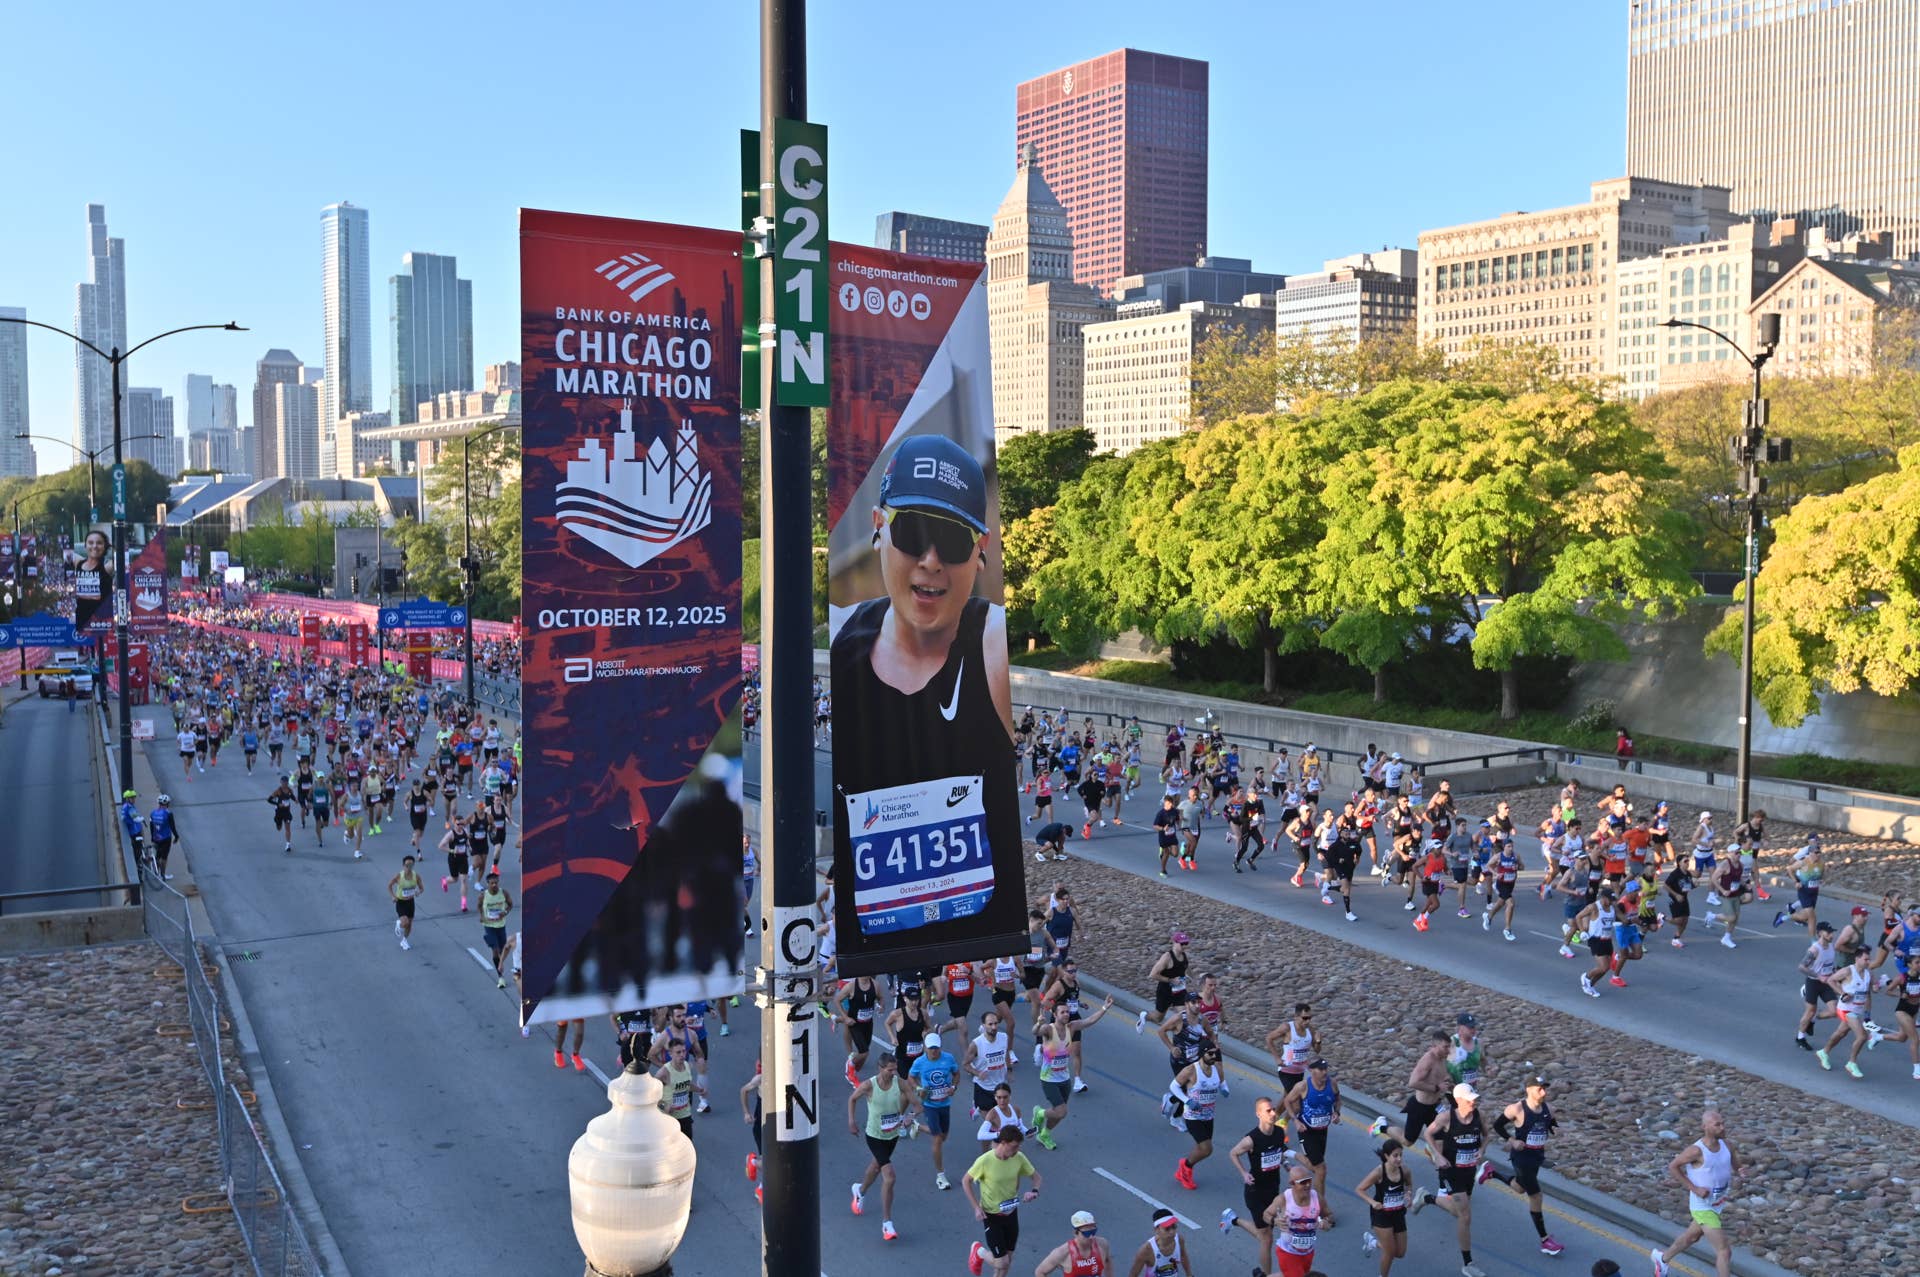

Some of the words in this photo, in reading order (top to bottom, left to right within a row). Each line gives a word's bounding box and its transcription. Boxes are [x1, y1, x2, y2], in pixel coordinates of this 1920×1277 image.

[779, 144, 824, 384] C21N
[837, 260, 958, 287] chicagomarathon.com
[1116, 299, 1161, 312] MOTOROLA
[556, 307, 604, 322] BANK
[609, 311, 632, 324] OF
[635, 313, 711, 331] AMERICA
[555, 328, 712, 370] CHICAGO
[556, 367, 711, 400] MARATHON
[113, 469, 125, 514] C11N
[538, 608, 640, 629] OCTOBER
[646, 607, 674, 629] 12,
[677, 606, 726, 625] 2025
[595, 669, 624, 677] WORLD
[625, 667, 671, 676] MARATHON
[671, 665, 702, 674] MAJORS
[596, 660, 626, 669] ABBOTT
[951, 785, 969, 798] RUN
[881, 803, 911, 813] Chicago
[882, 810, 920, 822] Marathon
[855, 842, 876, 881] G
[886, 822, 983, 874] 41351
[900, 885, 926, 895] October
[940, 878, 955, 887] 2024
[868, 918, 885, 926] ROW
[781, 917, 816, 1130] C21N
[1077, 1257, 1097, 1268] WADE
